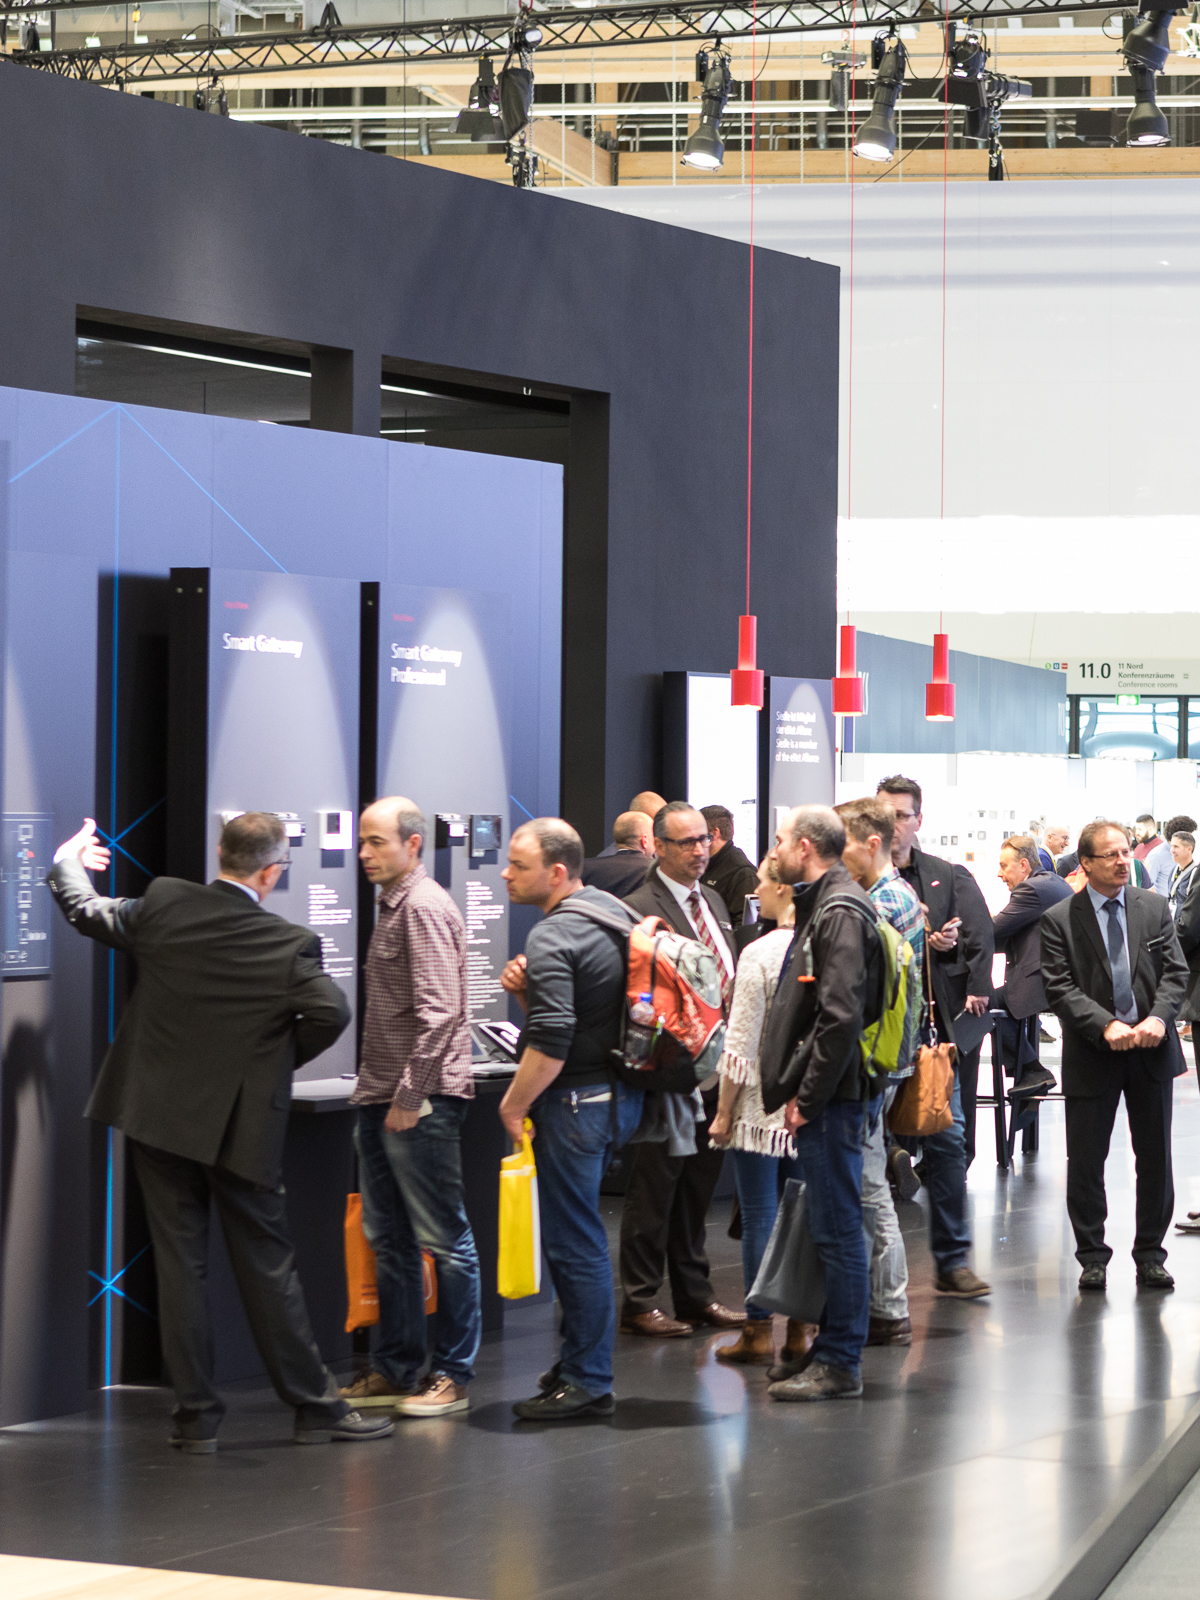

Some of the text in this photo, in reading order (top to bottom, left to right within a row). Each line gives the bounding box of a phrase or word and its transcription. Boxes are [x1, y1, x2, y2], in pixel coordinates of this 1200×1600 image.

[222, 632, 304, 658] Smart Gateway
[391, 643, 463, 667] Smart Gateway
[391, 667, 446, 686] Professional
[1079, 663, 1111, 678] 11.0
